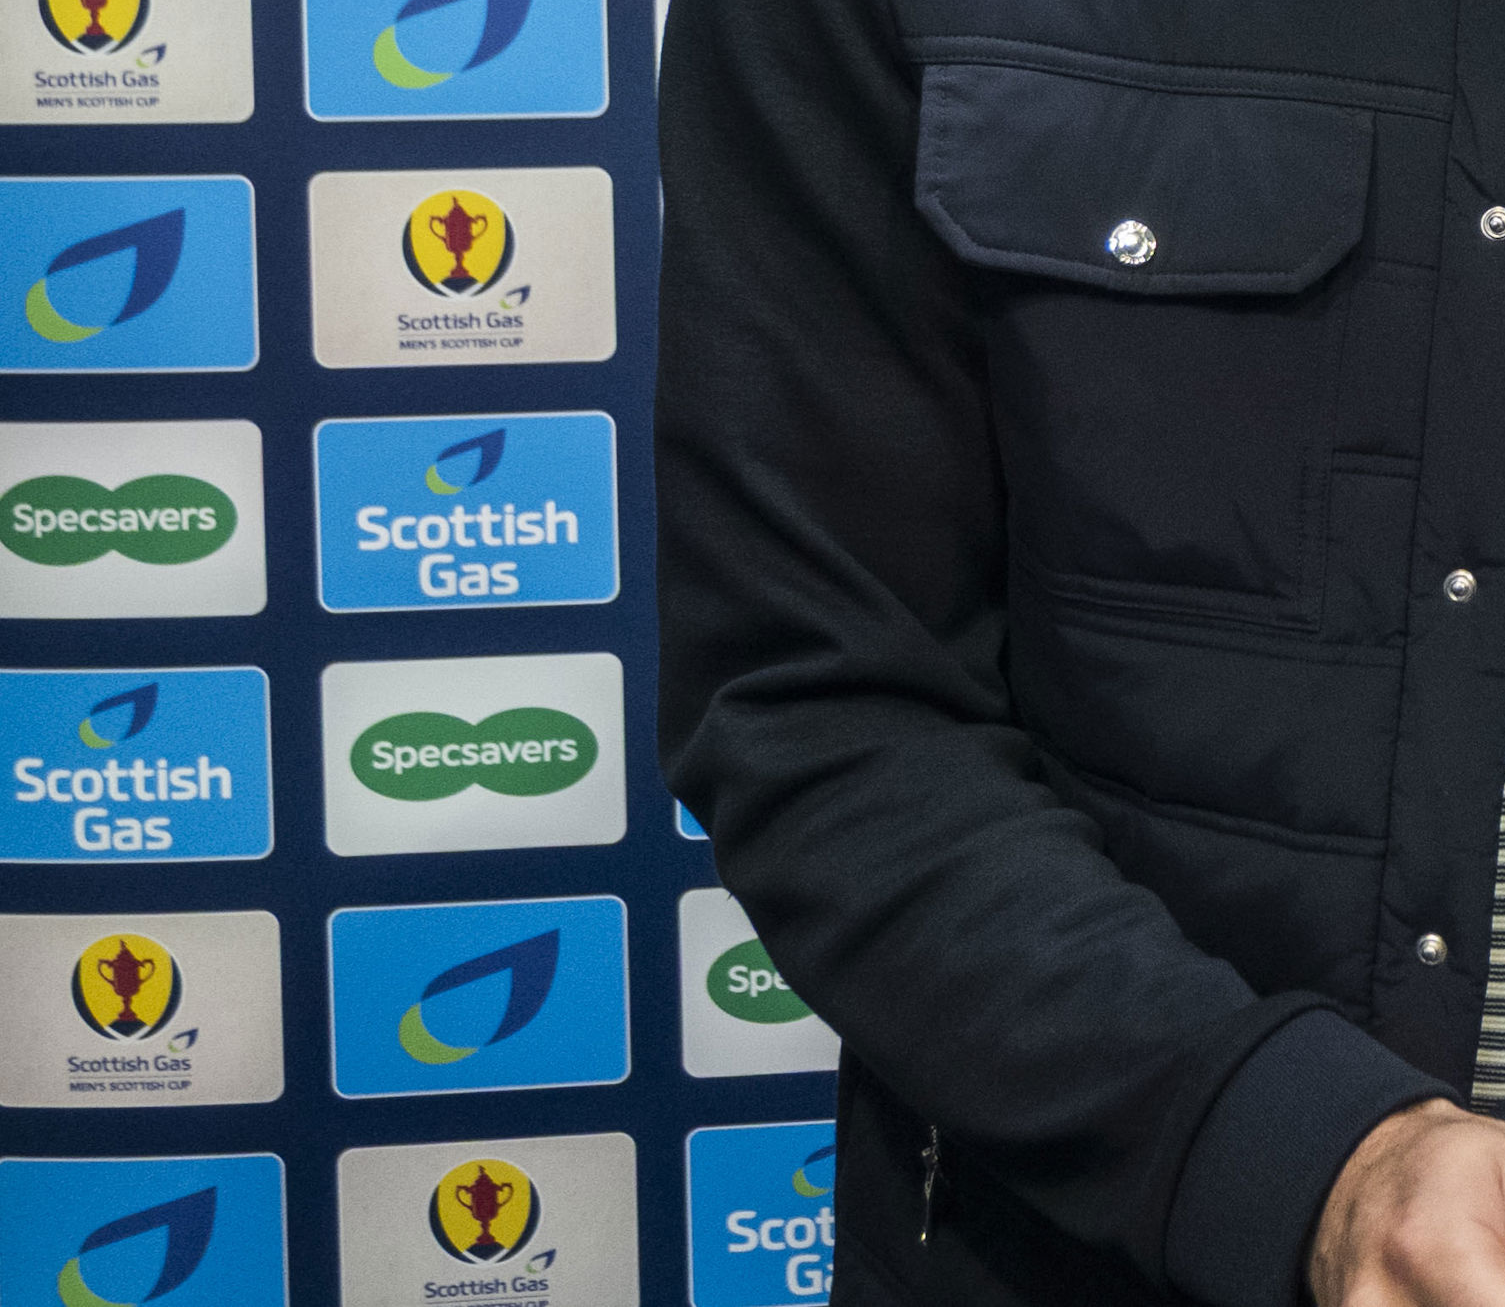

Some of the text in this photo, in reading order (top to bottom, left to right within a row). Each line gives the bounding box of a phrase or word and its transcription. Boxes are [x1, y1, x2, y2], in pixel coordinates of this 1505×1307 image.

[34, 71, 159, 89] Scottish Gas
[397, 313, 524, 331] Scottish Gas
[13, 503, 217, 538] Specsavers
[356, 500, 578, 551] Scottish
[419, 553, 519, 597] Gas
[372, 739, 578, 775] Specsavers
[14, 755, 232, 802] Scottish
[73, 807, 172, 851] Gas
[67, 1055, 191, 1073] Scottish Gas
[726, 1207, 835, 1253] Scot
[424, 1276, 549, 1300] Scottish Gas
